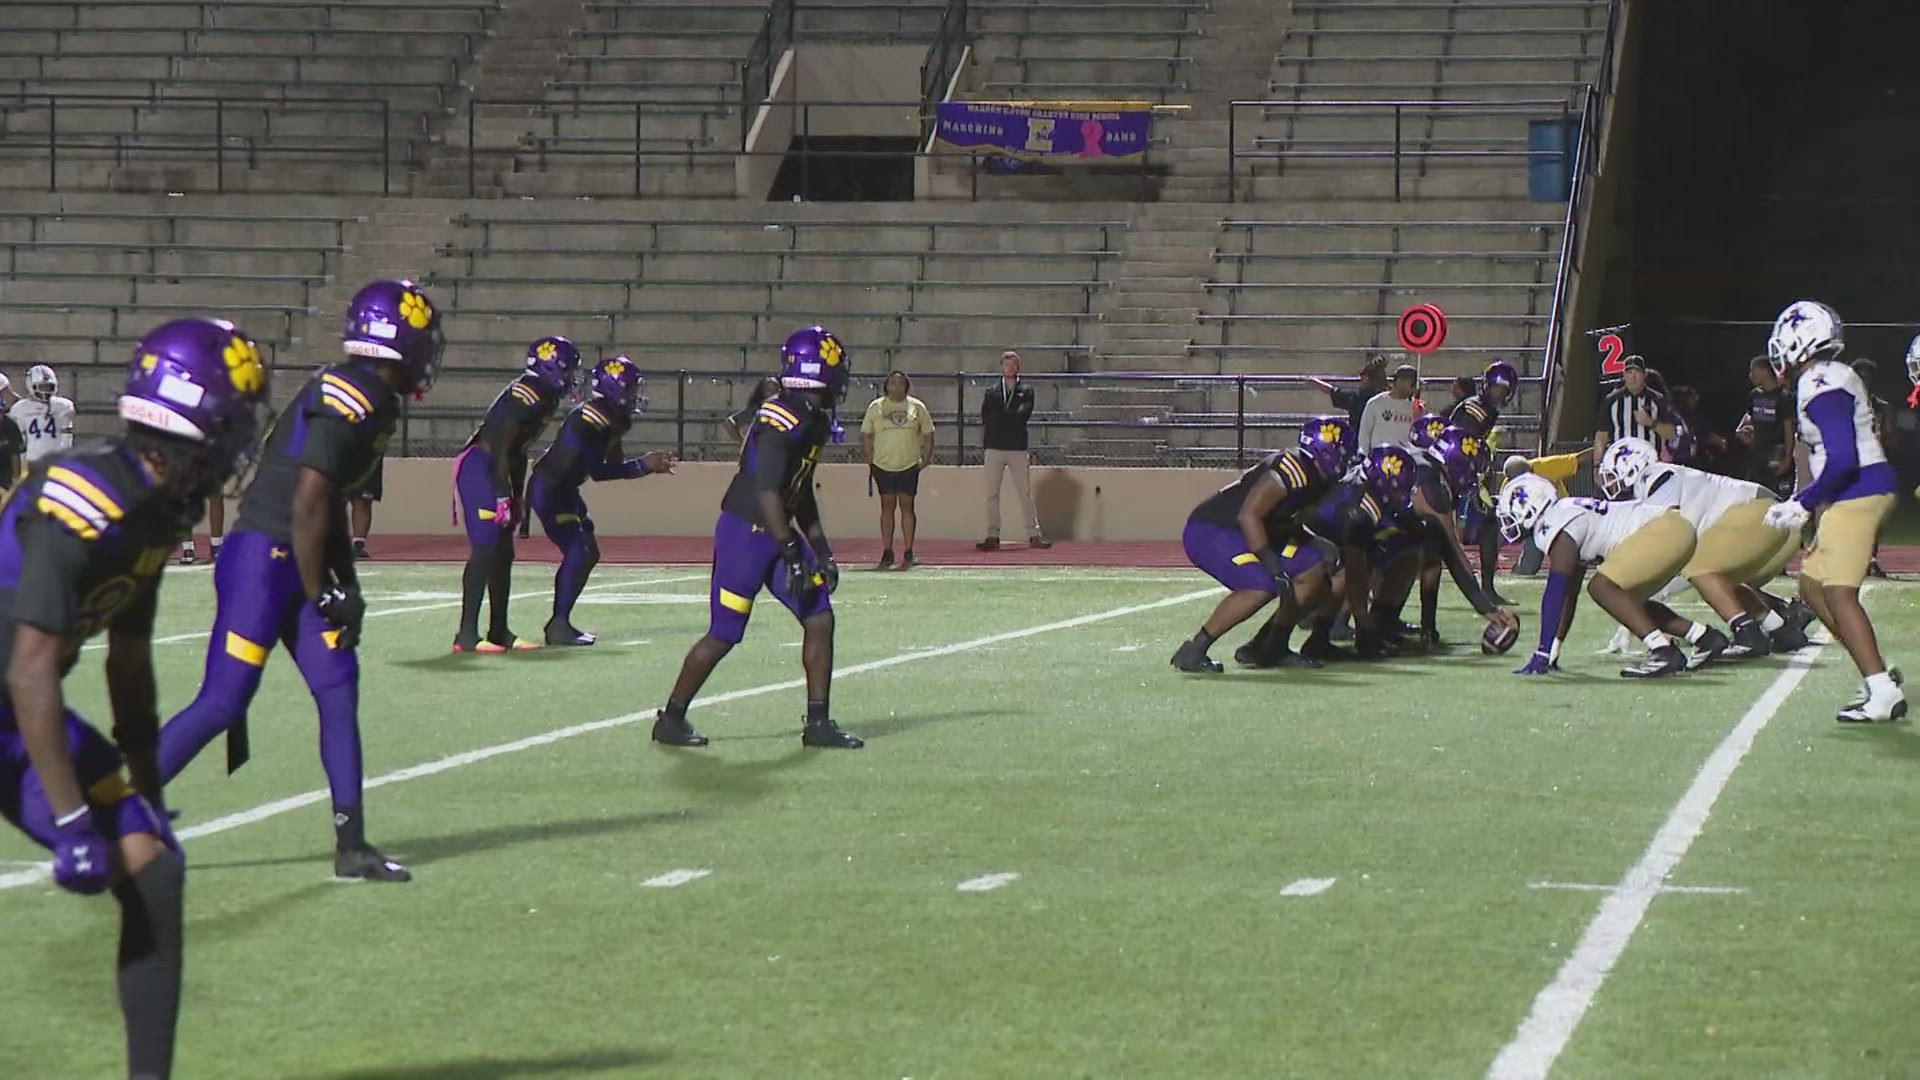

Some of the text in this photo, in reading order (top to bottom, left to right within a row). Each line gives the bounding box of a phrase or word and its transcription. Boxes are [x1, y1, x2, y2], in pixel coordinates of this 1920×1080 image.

[943, 120, 1136, 143] MARCHING BAND
[1597, 334, 1625, 375] 2
[28, 416, 57, 439] 44
